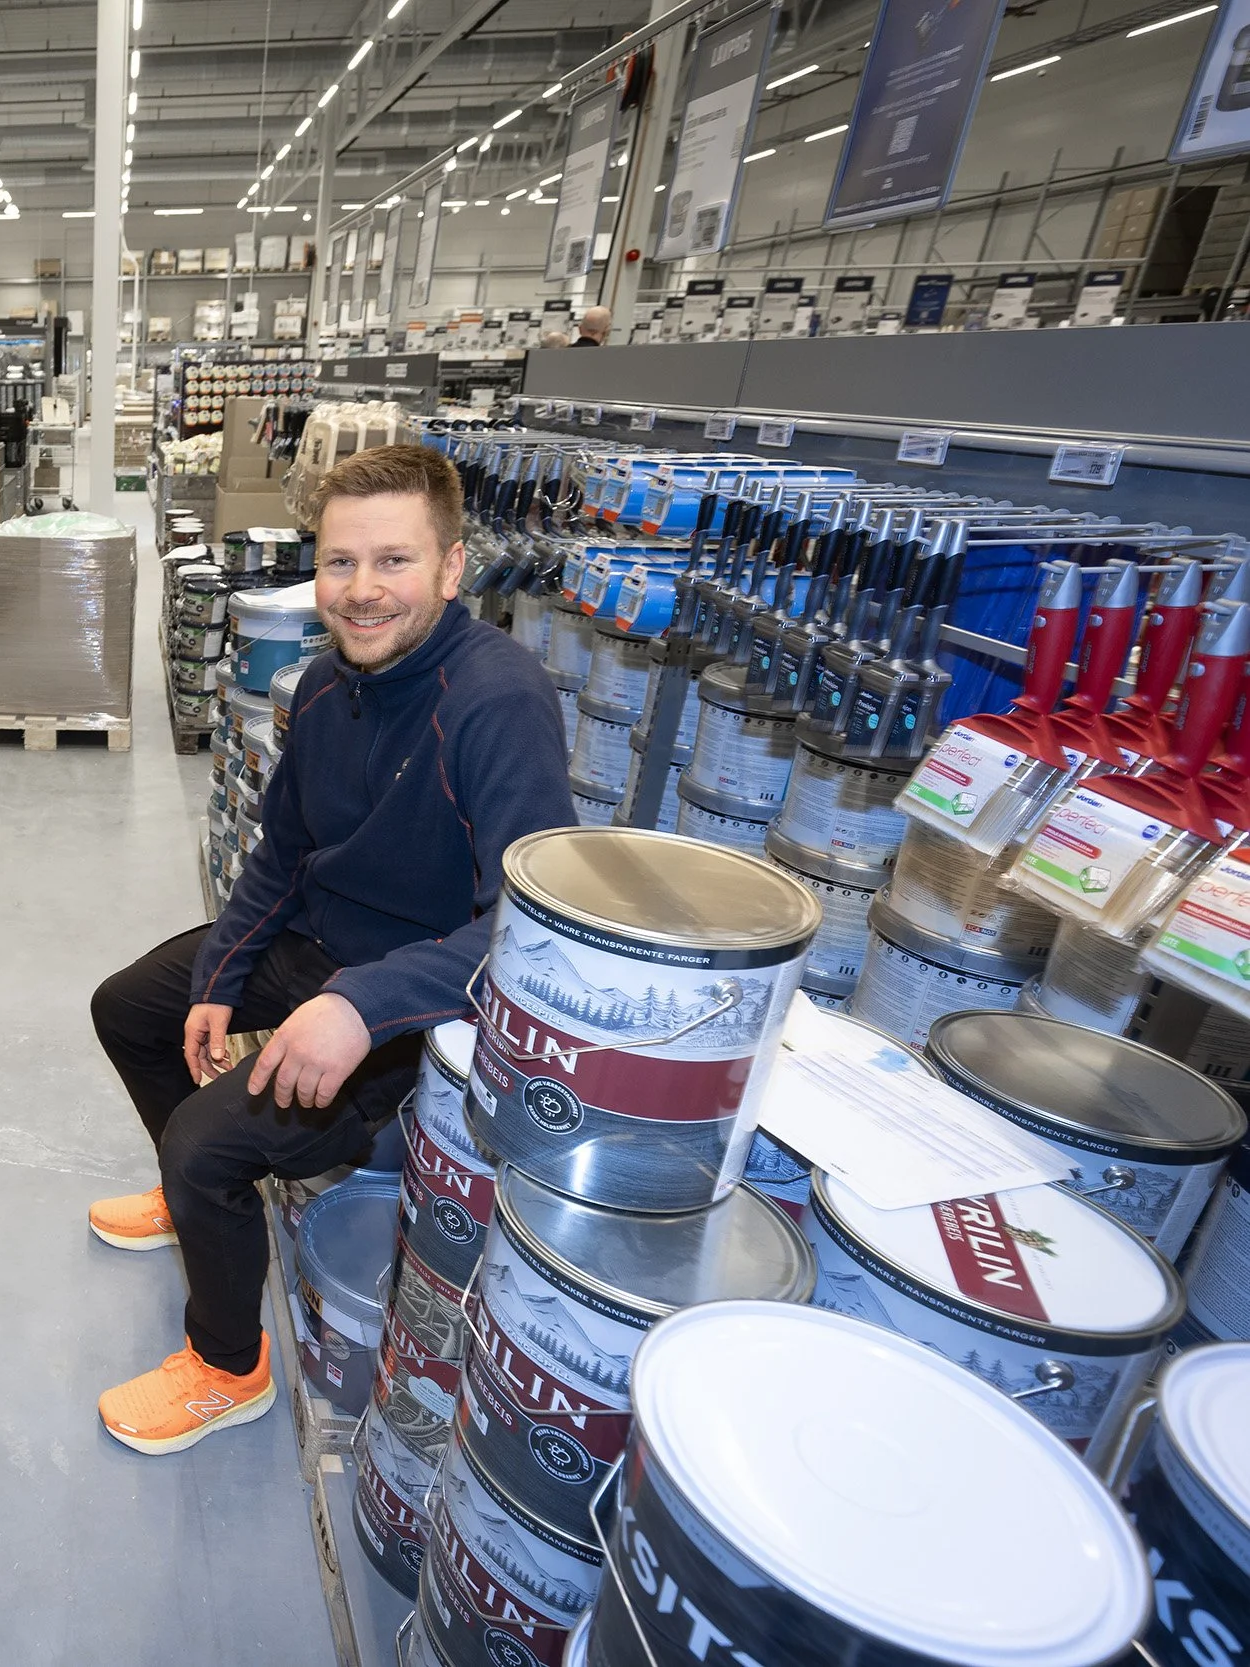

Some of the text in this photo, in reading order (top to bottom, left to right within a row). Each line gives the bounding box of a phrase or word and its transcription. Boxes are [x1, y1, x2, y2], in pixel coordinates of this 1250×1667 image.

[1026, 642, 1037, 674] Jordan
[953, 730, 975, 742] Jordan
[938, 743, 984, 768] perfect
[1076, 792, 1103, 808] Jordan
[1054, 806, 1114, 837] perfect
[554, 920, 711, 966] VAKRE TRANSPARENTE FARGER
[970, 1091, 1119, 1155] VAKRE TRANSPARENTE FARGER
[411, 1126, 473, 1199] ILIN
[559, 1279, 590, 1302] VAKRE
[866, 1258, 1047, 1346] VAKRE TRANSPARENTE FARGER
[508, 1504, 535, 1528] VAKRE
